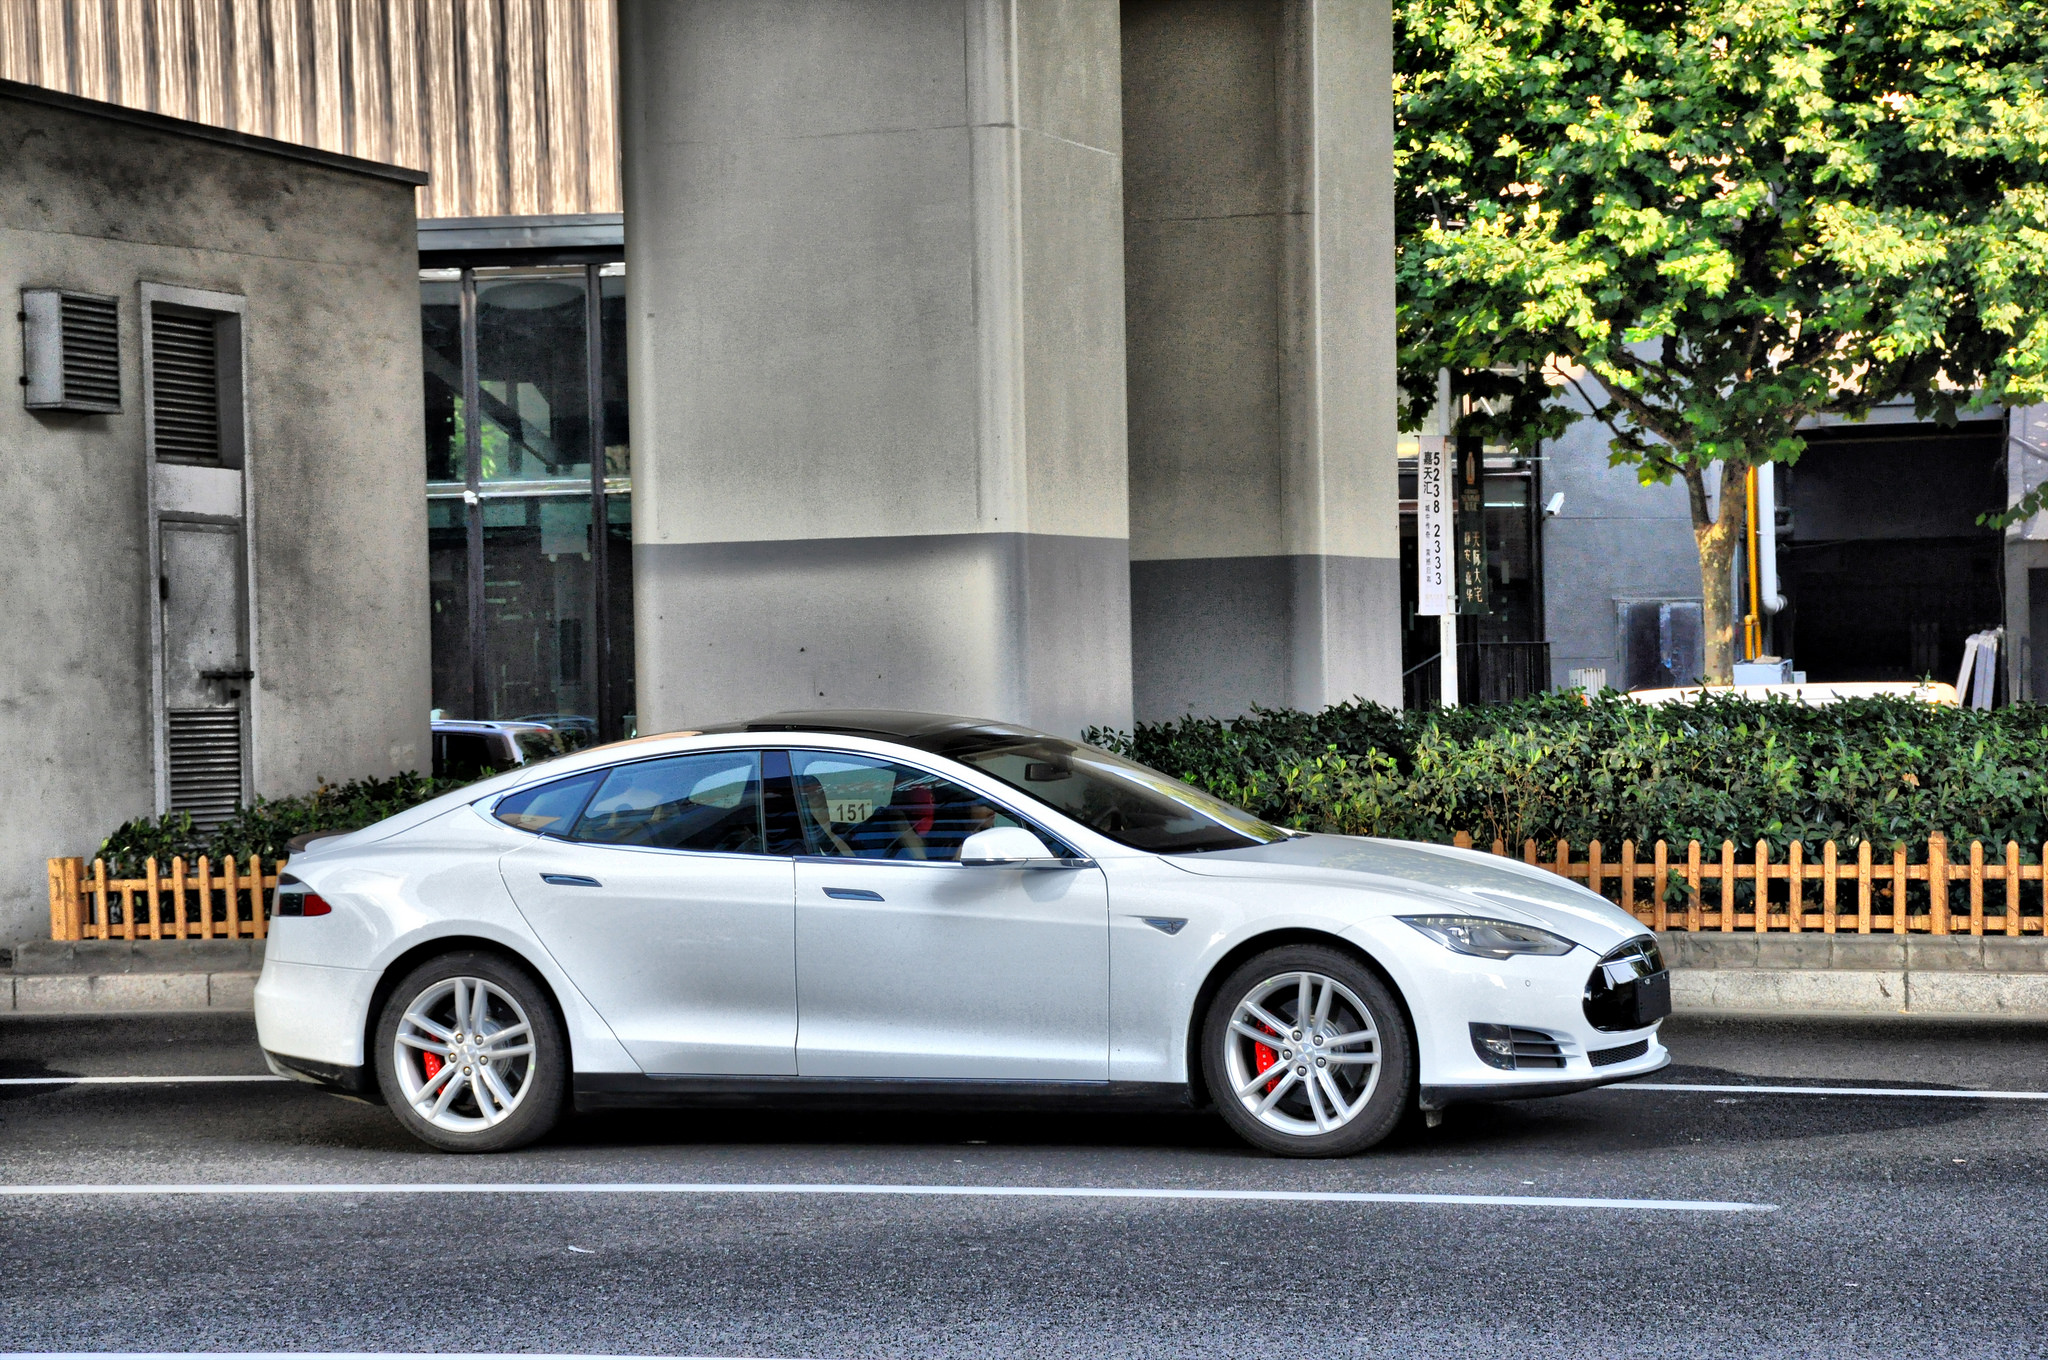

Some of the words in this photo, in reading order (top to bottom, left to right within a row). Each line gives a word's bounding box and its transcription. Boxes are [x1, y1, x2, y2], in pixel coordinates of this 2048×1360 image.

[1424, 451, 1433, 494] 嘉天汇
[1433, 452, 1441, 514] 5238
[1434, 523, 1442, 586] 2333
[837, 803, 865, 821] 151
